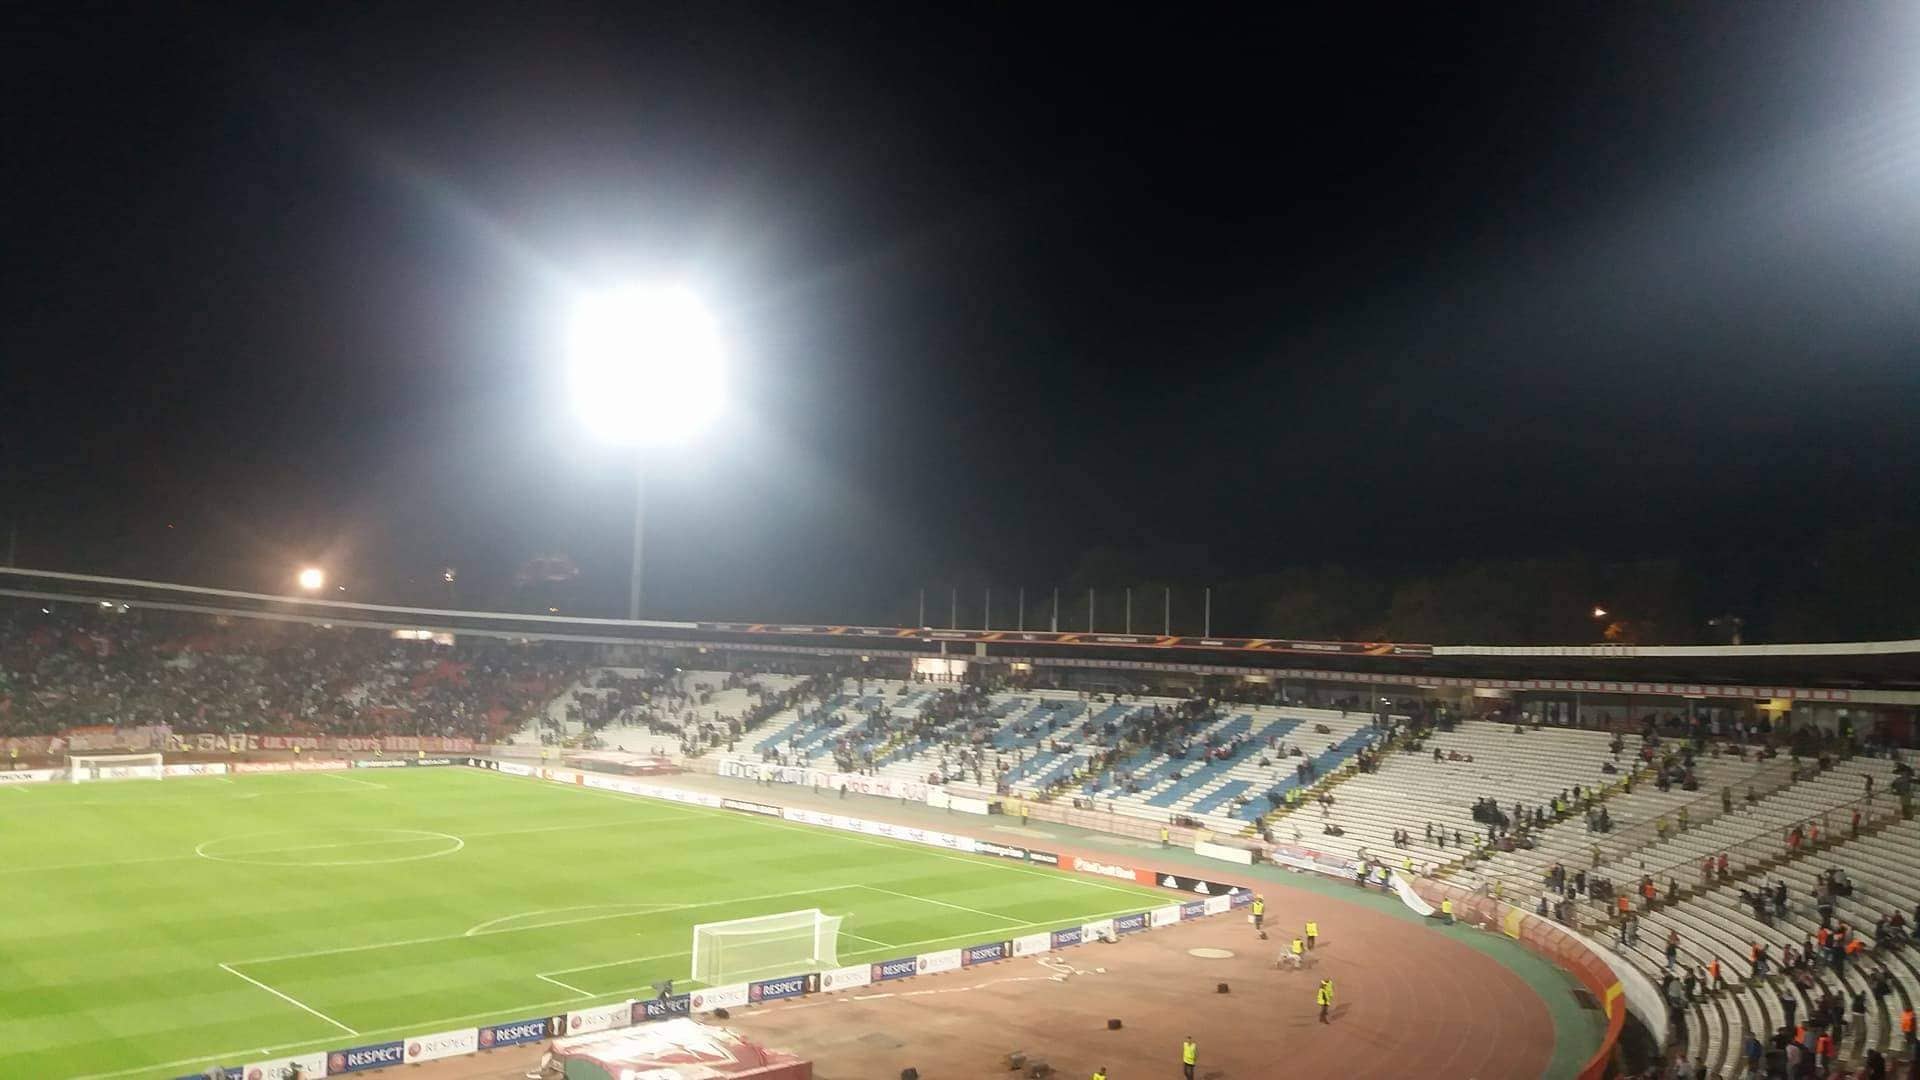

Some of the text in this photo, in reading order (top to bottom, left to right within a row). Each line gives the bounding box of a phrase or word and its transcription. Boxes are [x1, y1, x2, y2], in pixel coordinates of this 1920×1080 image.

[882, 962, 917, 976] RESPECT
[763, 981, 804, 996] RESPECT
[496, 1023, 546, 1042] RESPECT
[348, 1046, 403, 1067] RESPECT
